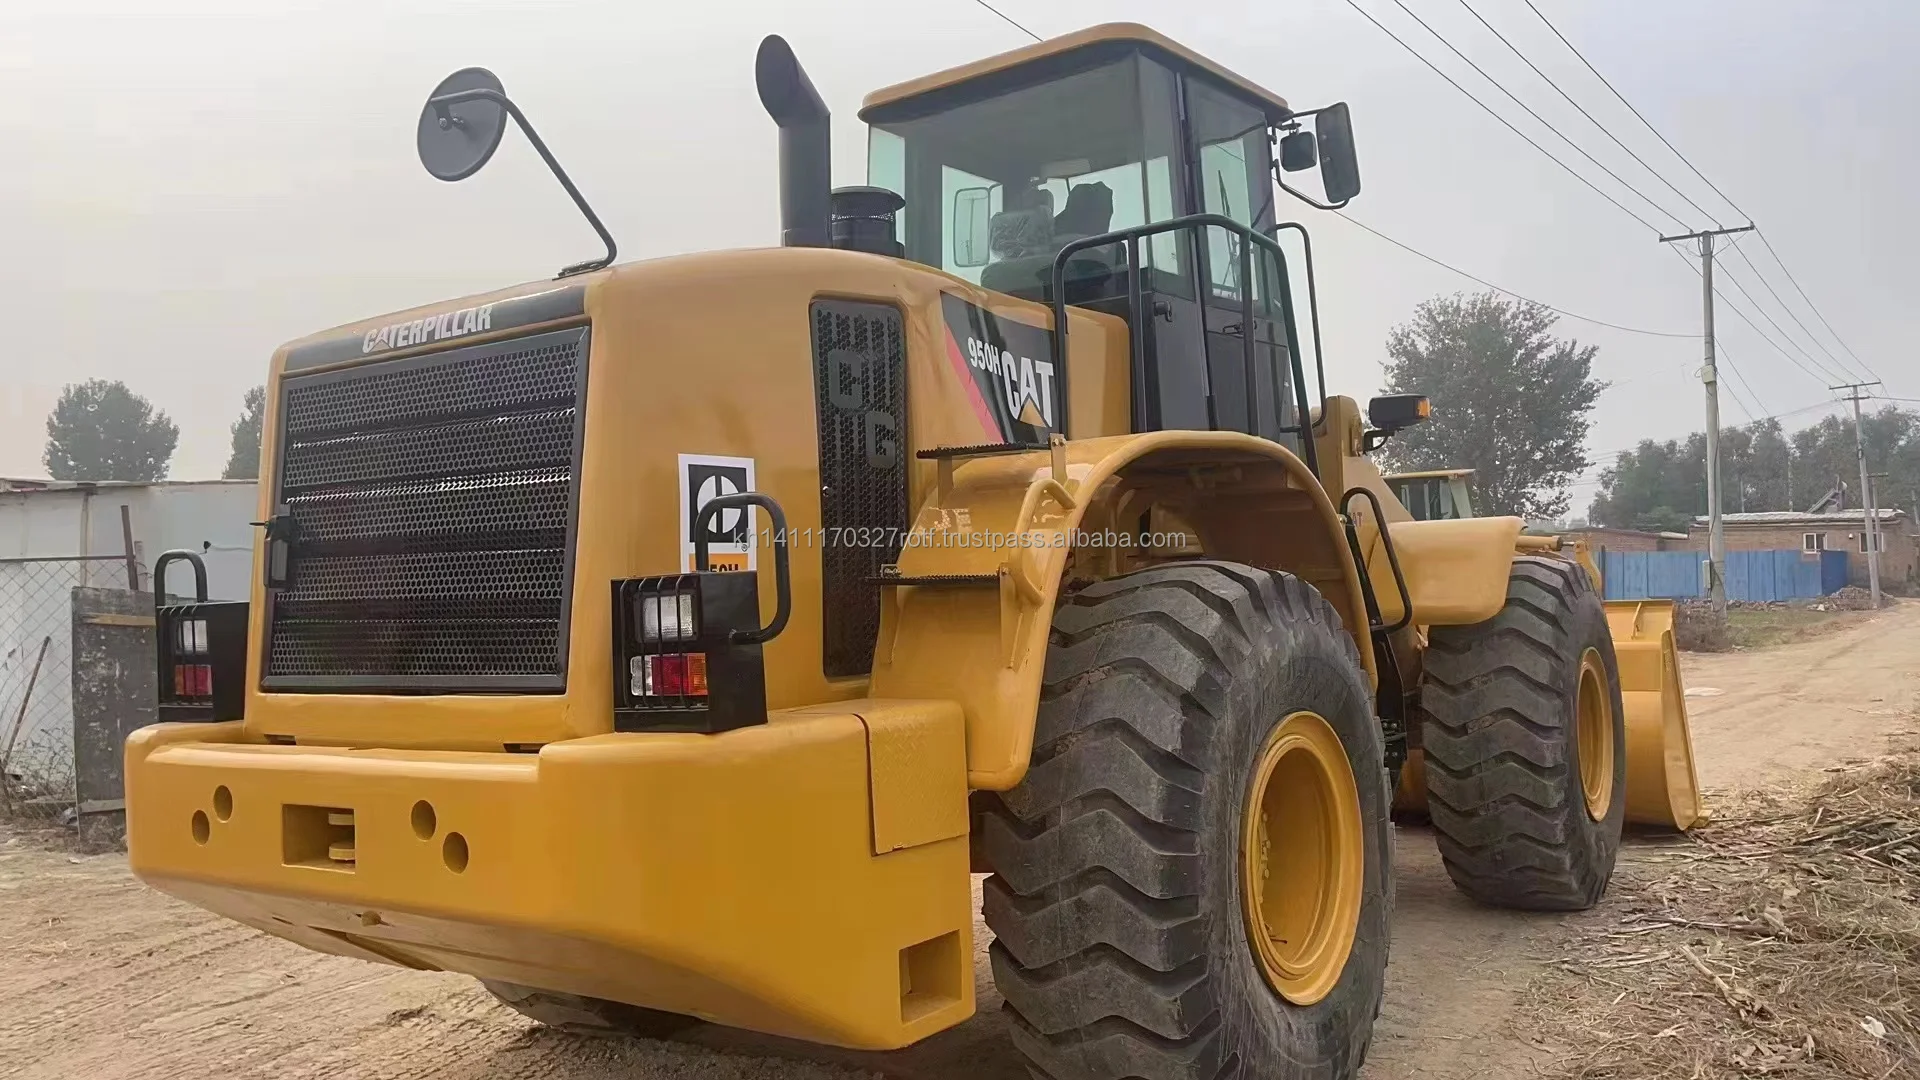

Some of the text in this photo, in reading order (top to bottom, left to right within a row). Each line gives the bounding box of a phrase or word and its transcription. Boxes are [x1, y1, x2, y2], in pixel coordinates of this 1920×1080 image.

[362, 304, 493, 354] CATERPILLAR
[967, 336, 1002, 376] 950H
[1001, 350, 1054, 428] CAT
